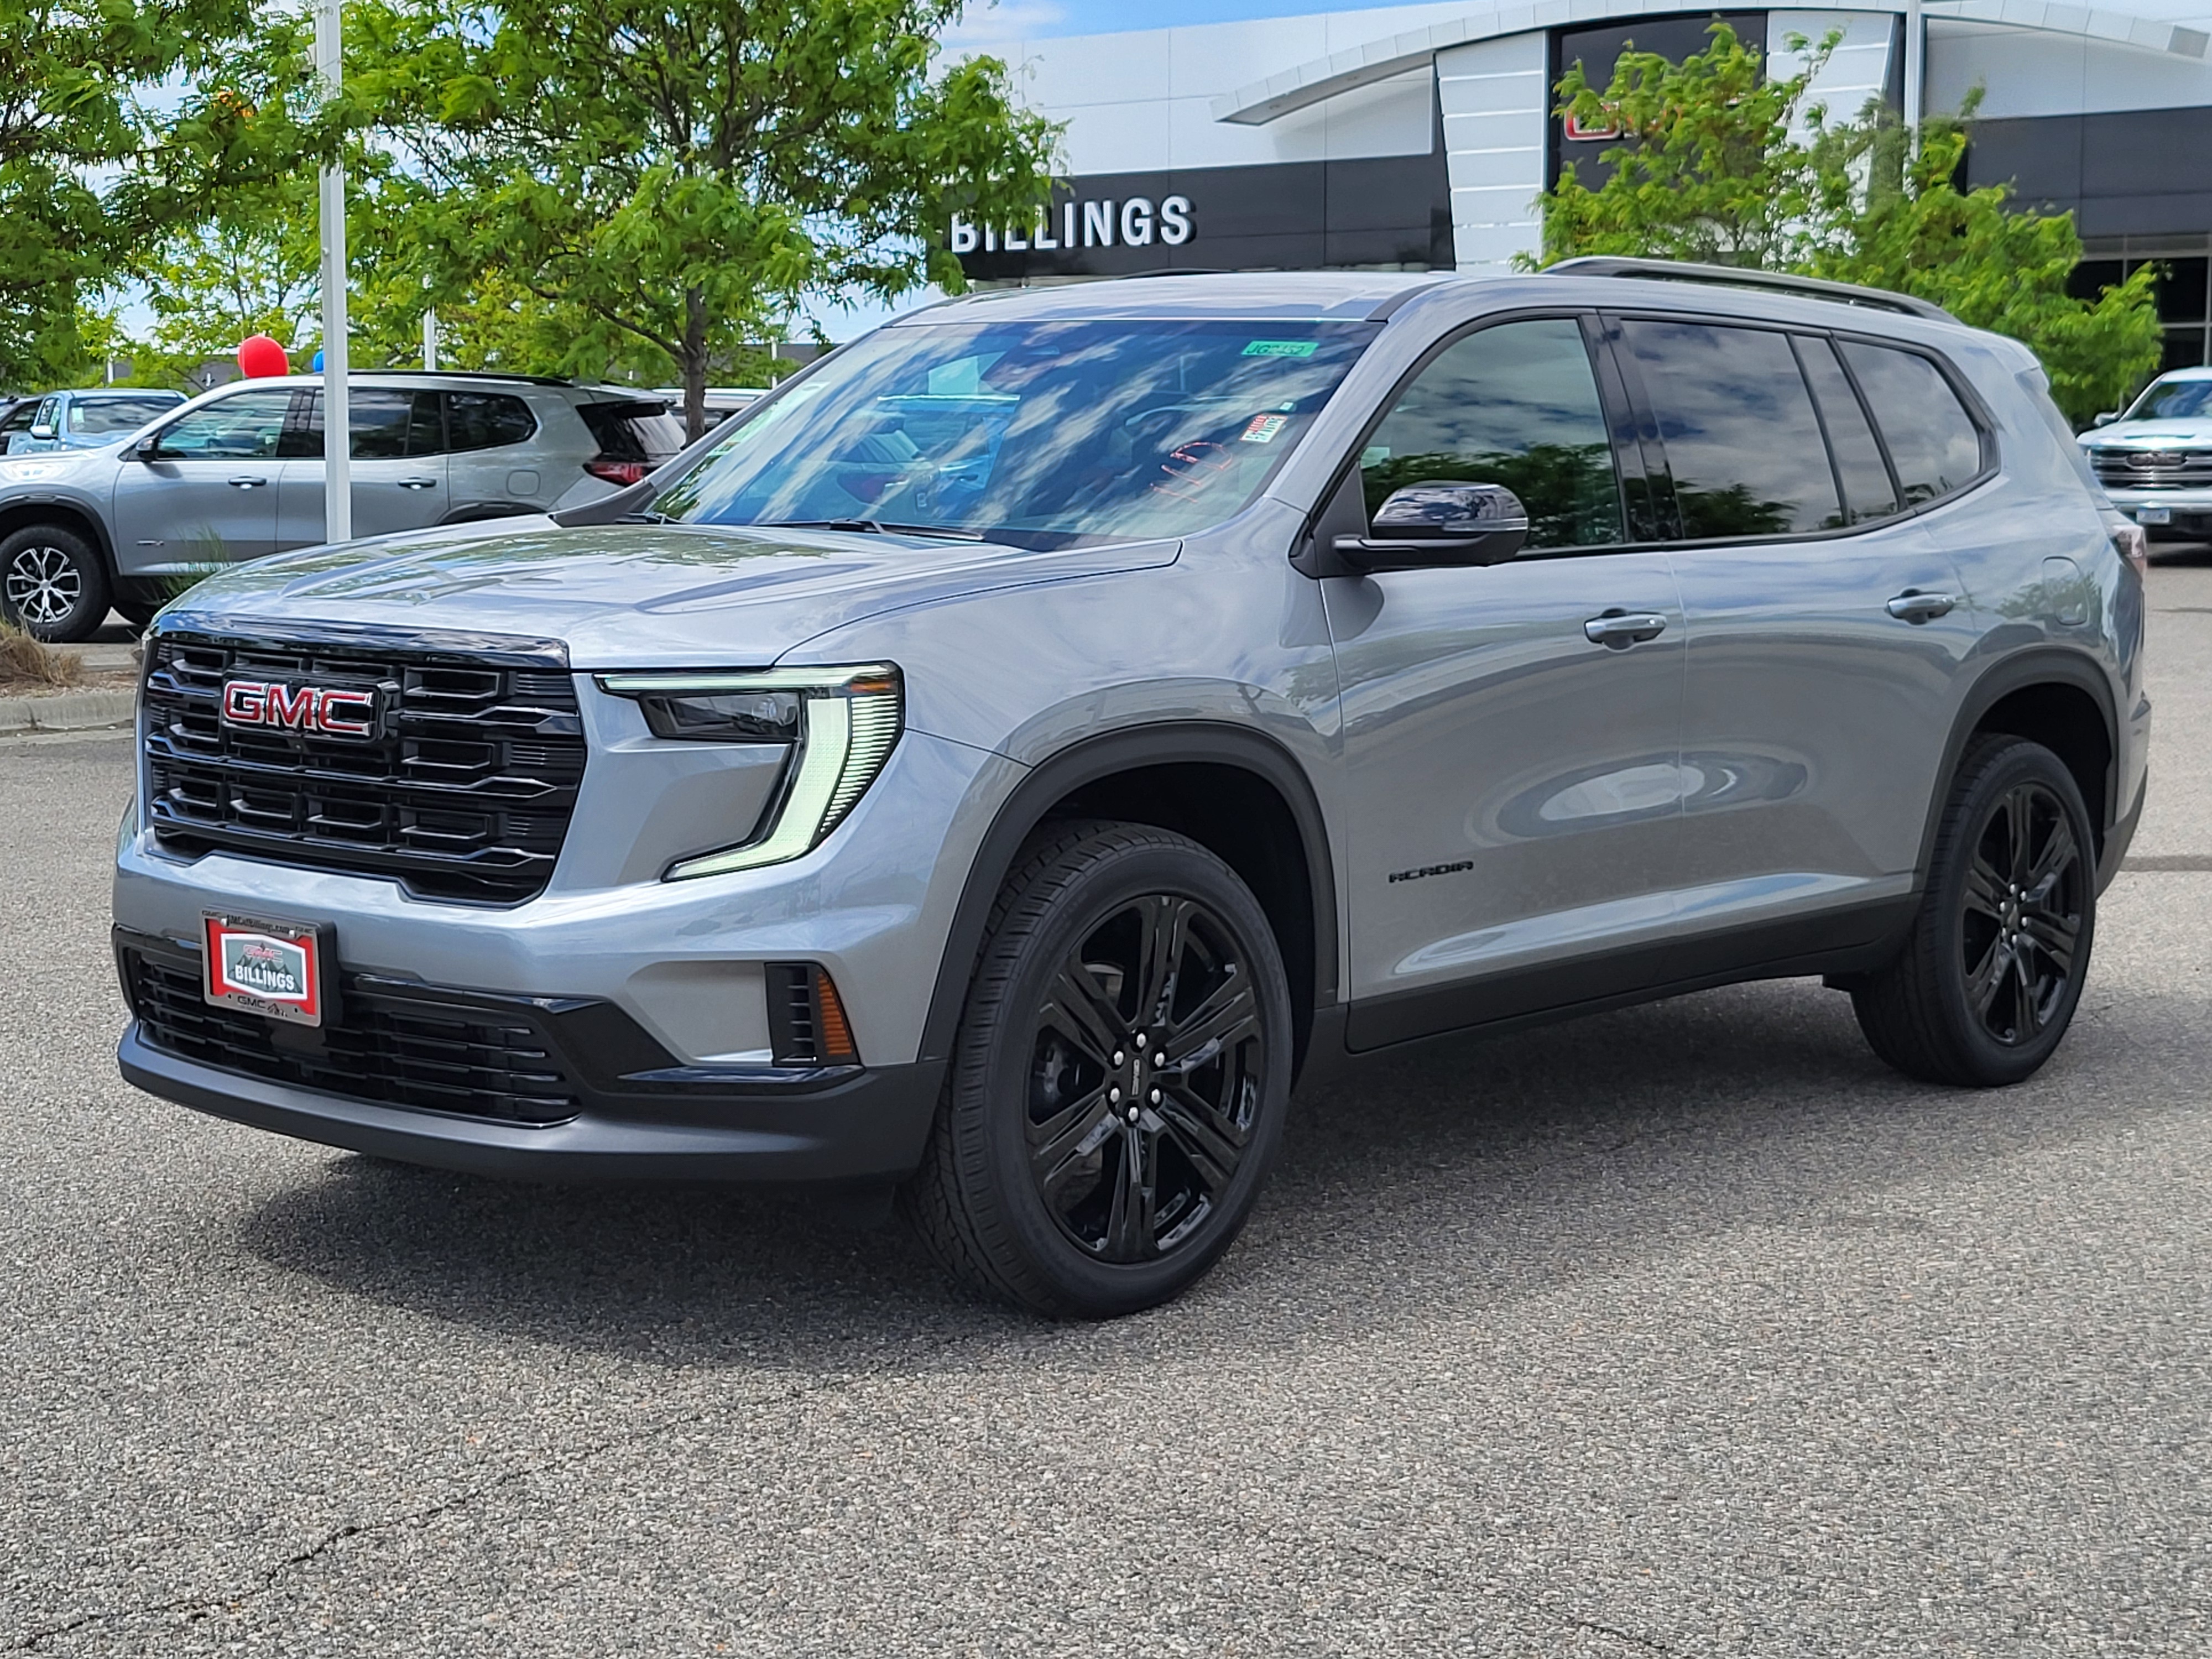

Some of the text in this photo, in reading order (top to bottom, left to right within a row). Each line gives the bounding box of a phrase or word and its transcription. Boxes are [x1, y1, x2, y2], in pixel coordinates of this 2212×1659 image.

[951, 195, 1196, 253] BILLINGS
[224, 680, 373, 736] GMC
[1389, 861, 1474, 883] ACADIA
[235, 964, 294, 990] BILLINGS
[237, 995, 265, 1009] GMC
